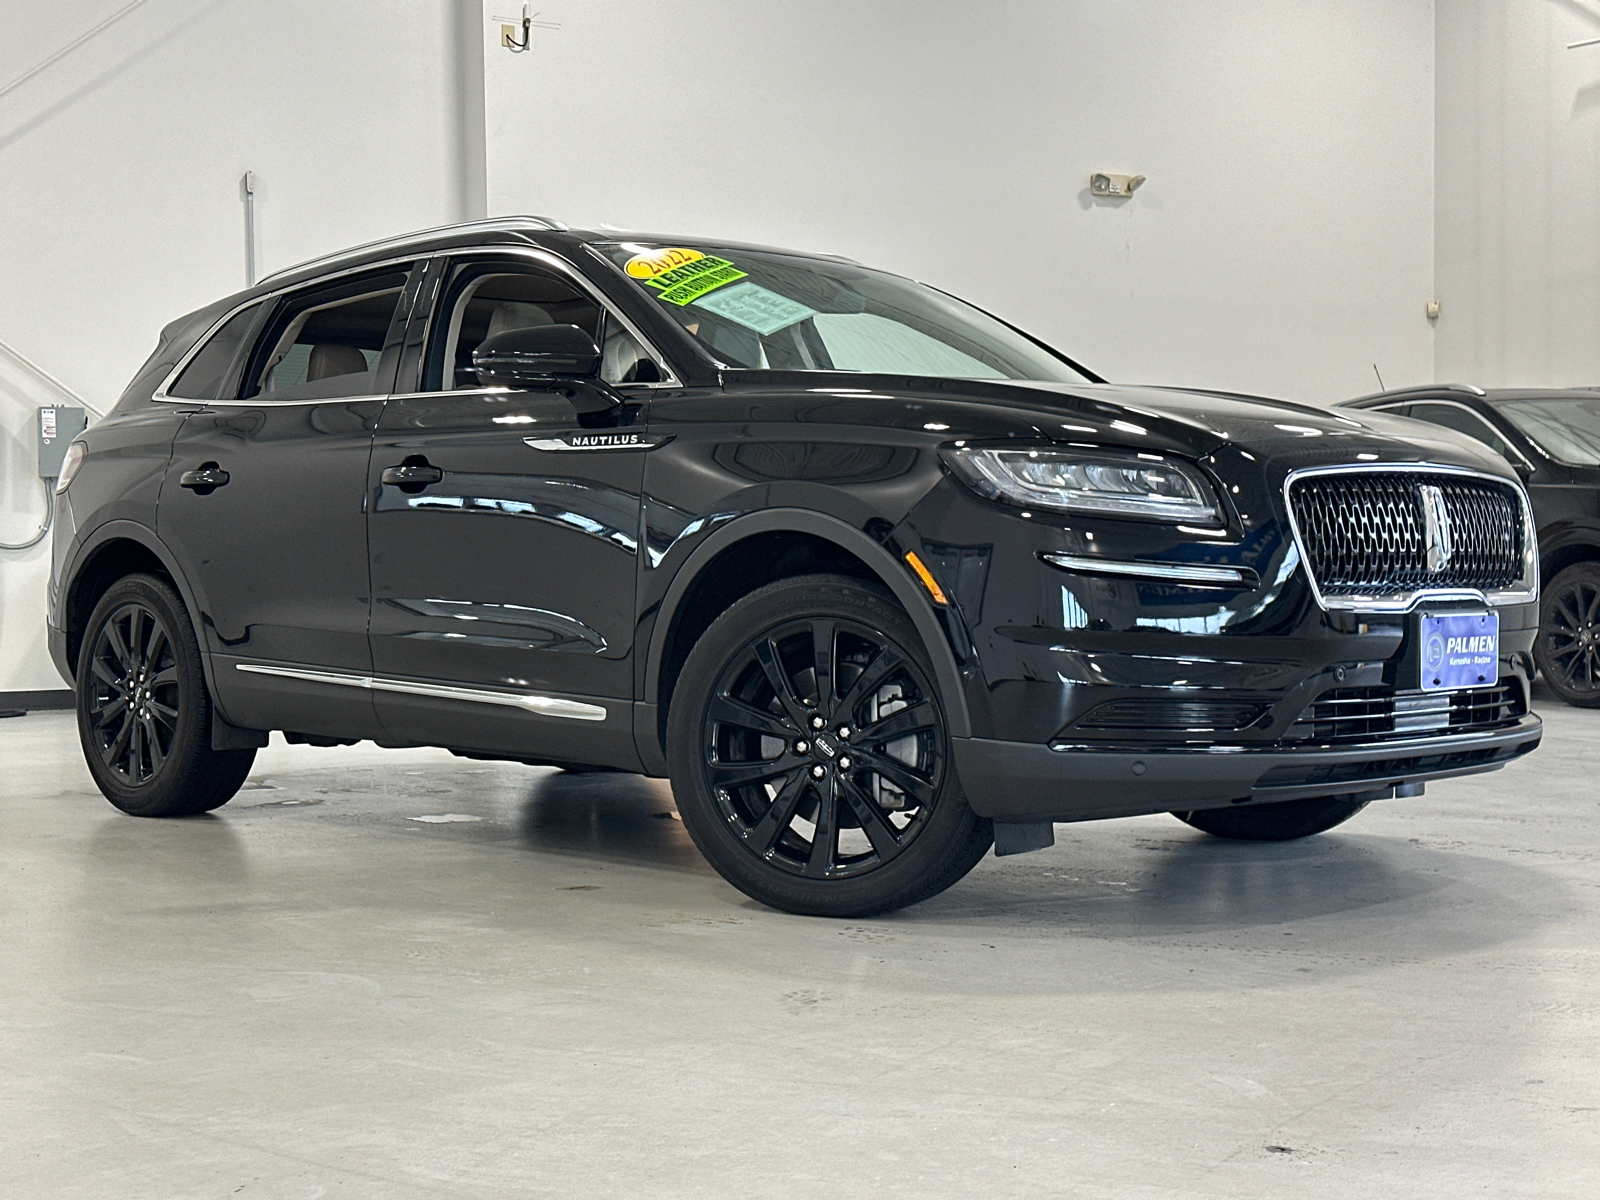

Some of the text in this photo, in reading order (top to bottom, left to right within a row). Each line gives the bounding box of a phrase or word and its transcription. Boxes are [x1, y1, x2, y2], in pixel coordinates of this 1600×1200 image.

[638, 250, 692, 275] 2022
[652, 256, 725, 288] LEATHER
[664, 285, 697, 303] PUSH
[572, 434, 638, 446] NAUTILUS
[1446, 635, 1496, 654] PALMEN
